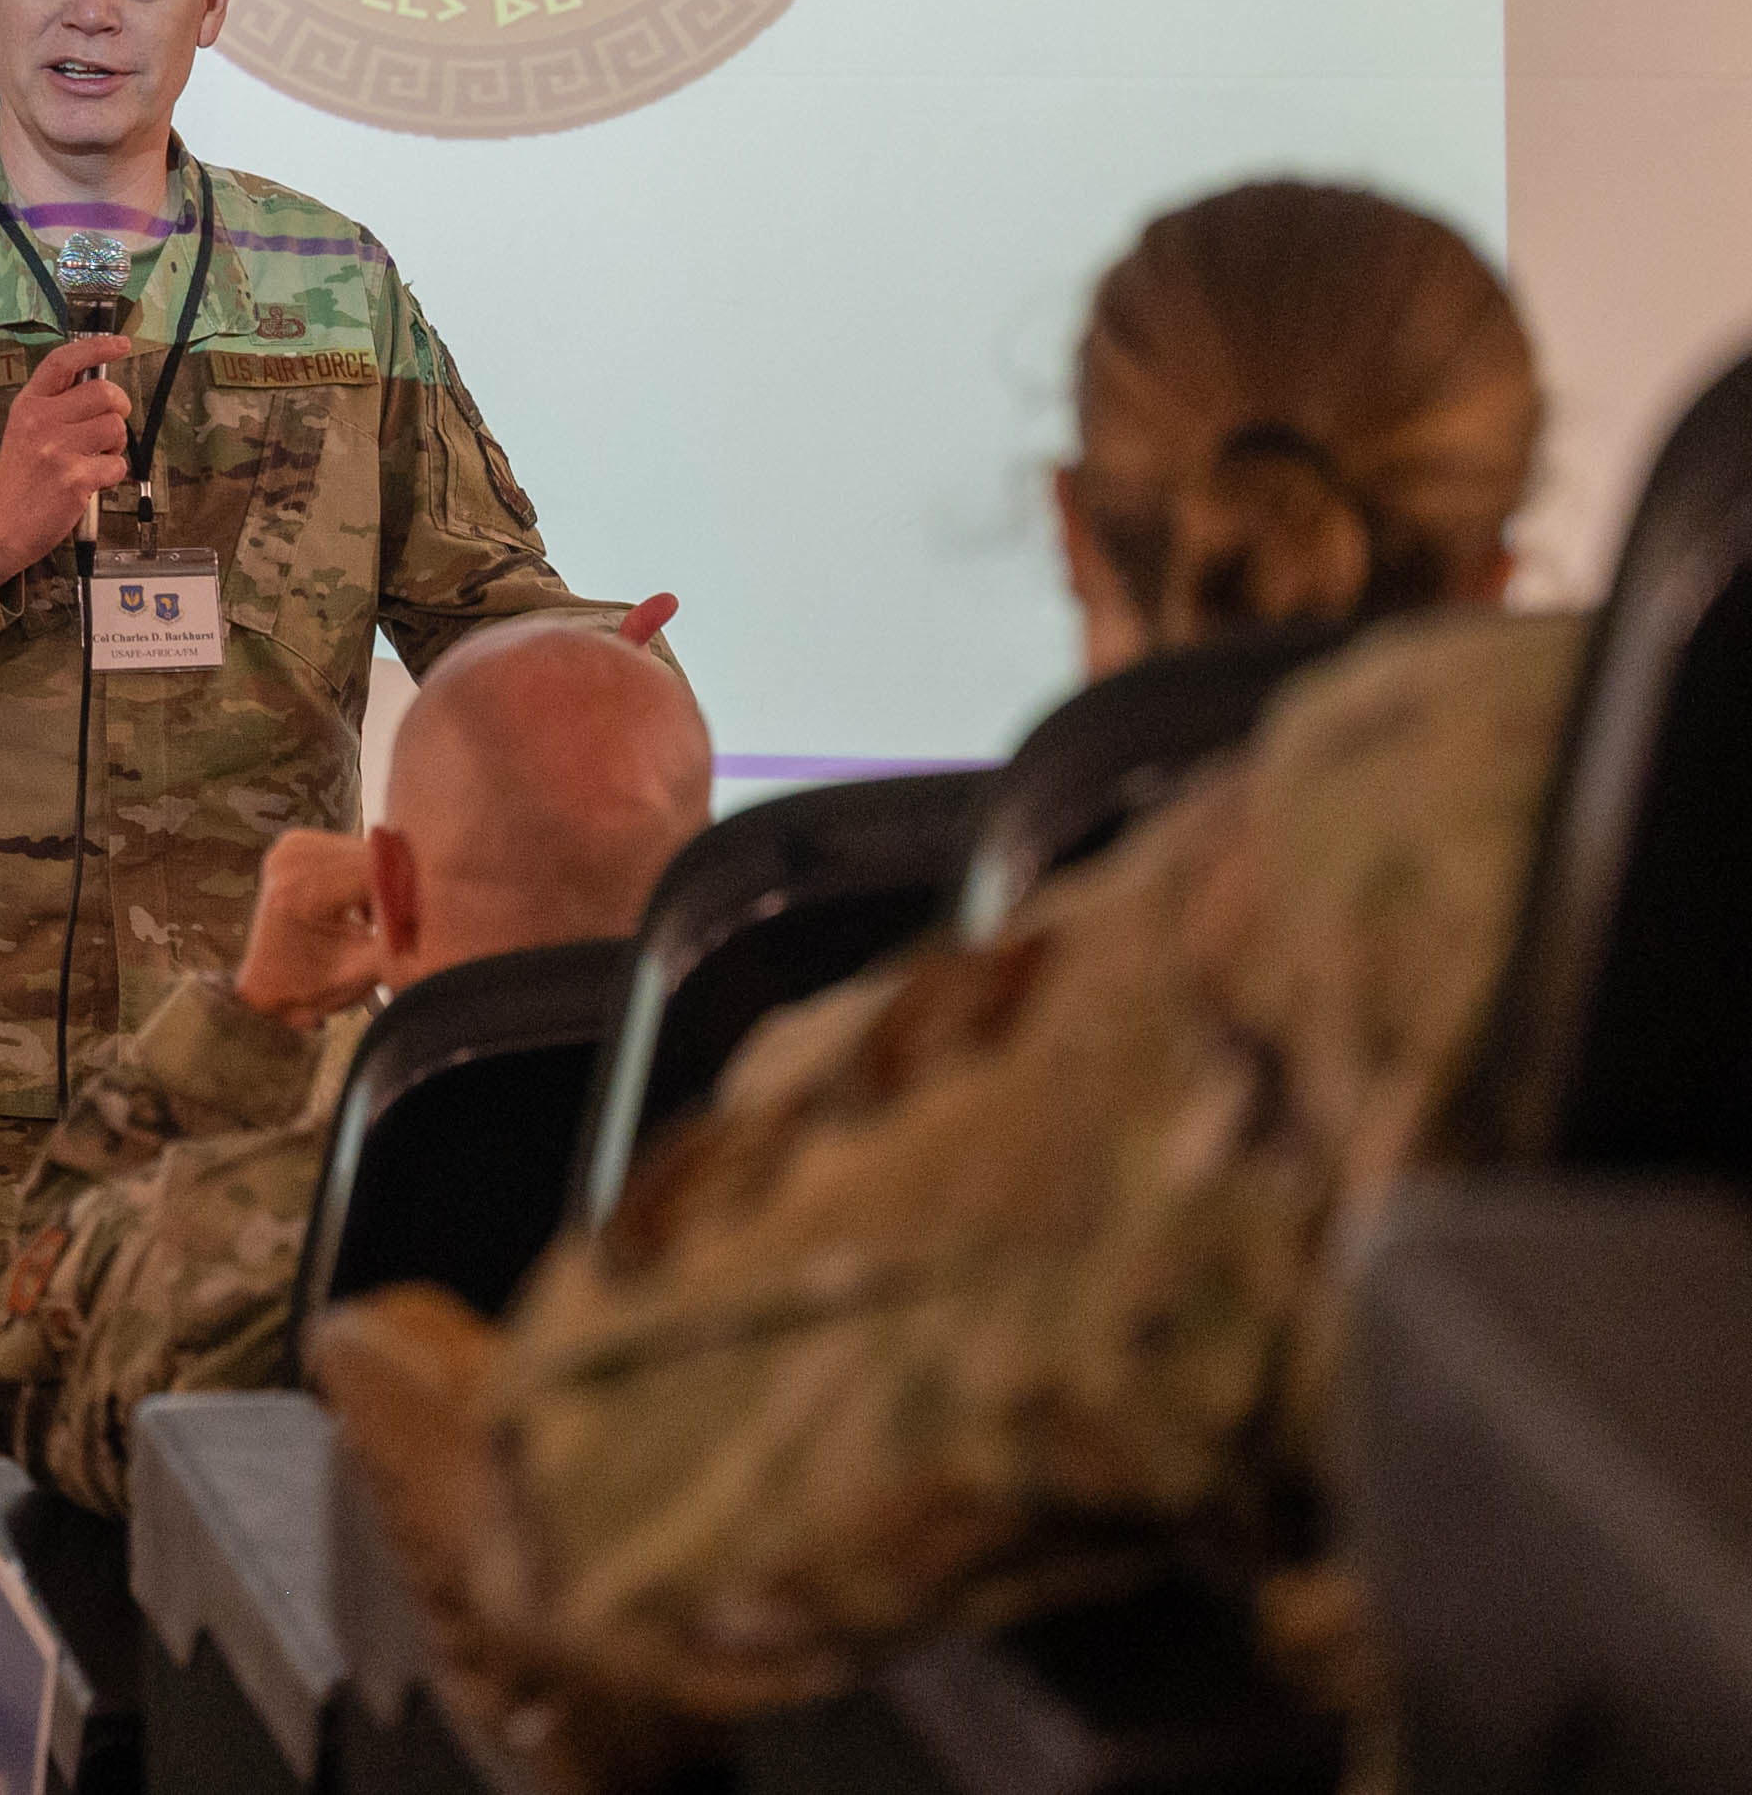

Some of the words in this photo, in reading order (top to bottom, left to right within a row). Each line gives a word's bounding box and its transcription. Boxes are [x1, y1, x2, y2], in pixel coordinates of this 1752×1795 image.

[262, 356, 299, 383] AIR
[302, 350, 373, 381] FORCE
[111, 631, 149, 644] Charles
[165, 630, 215, 642] Barkhurst
